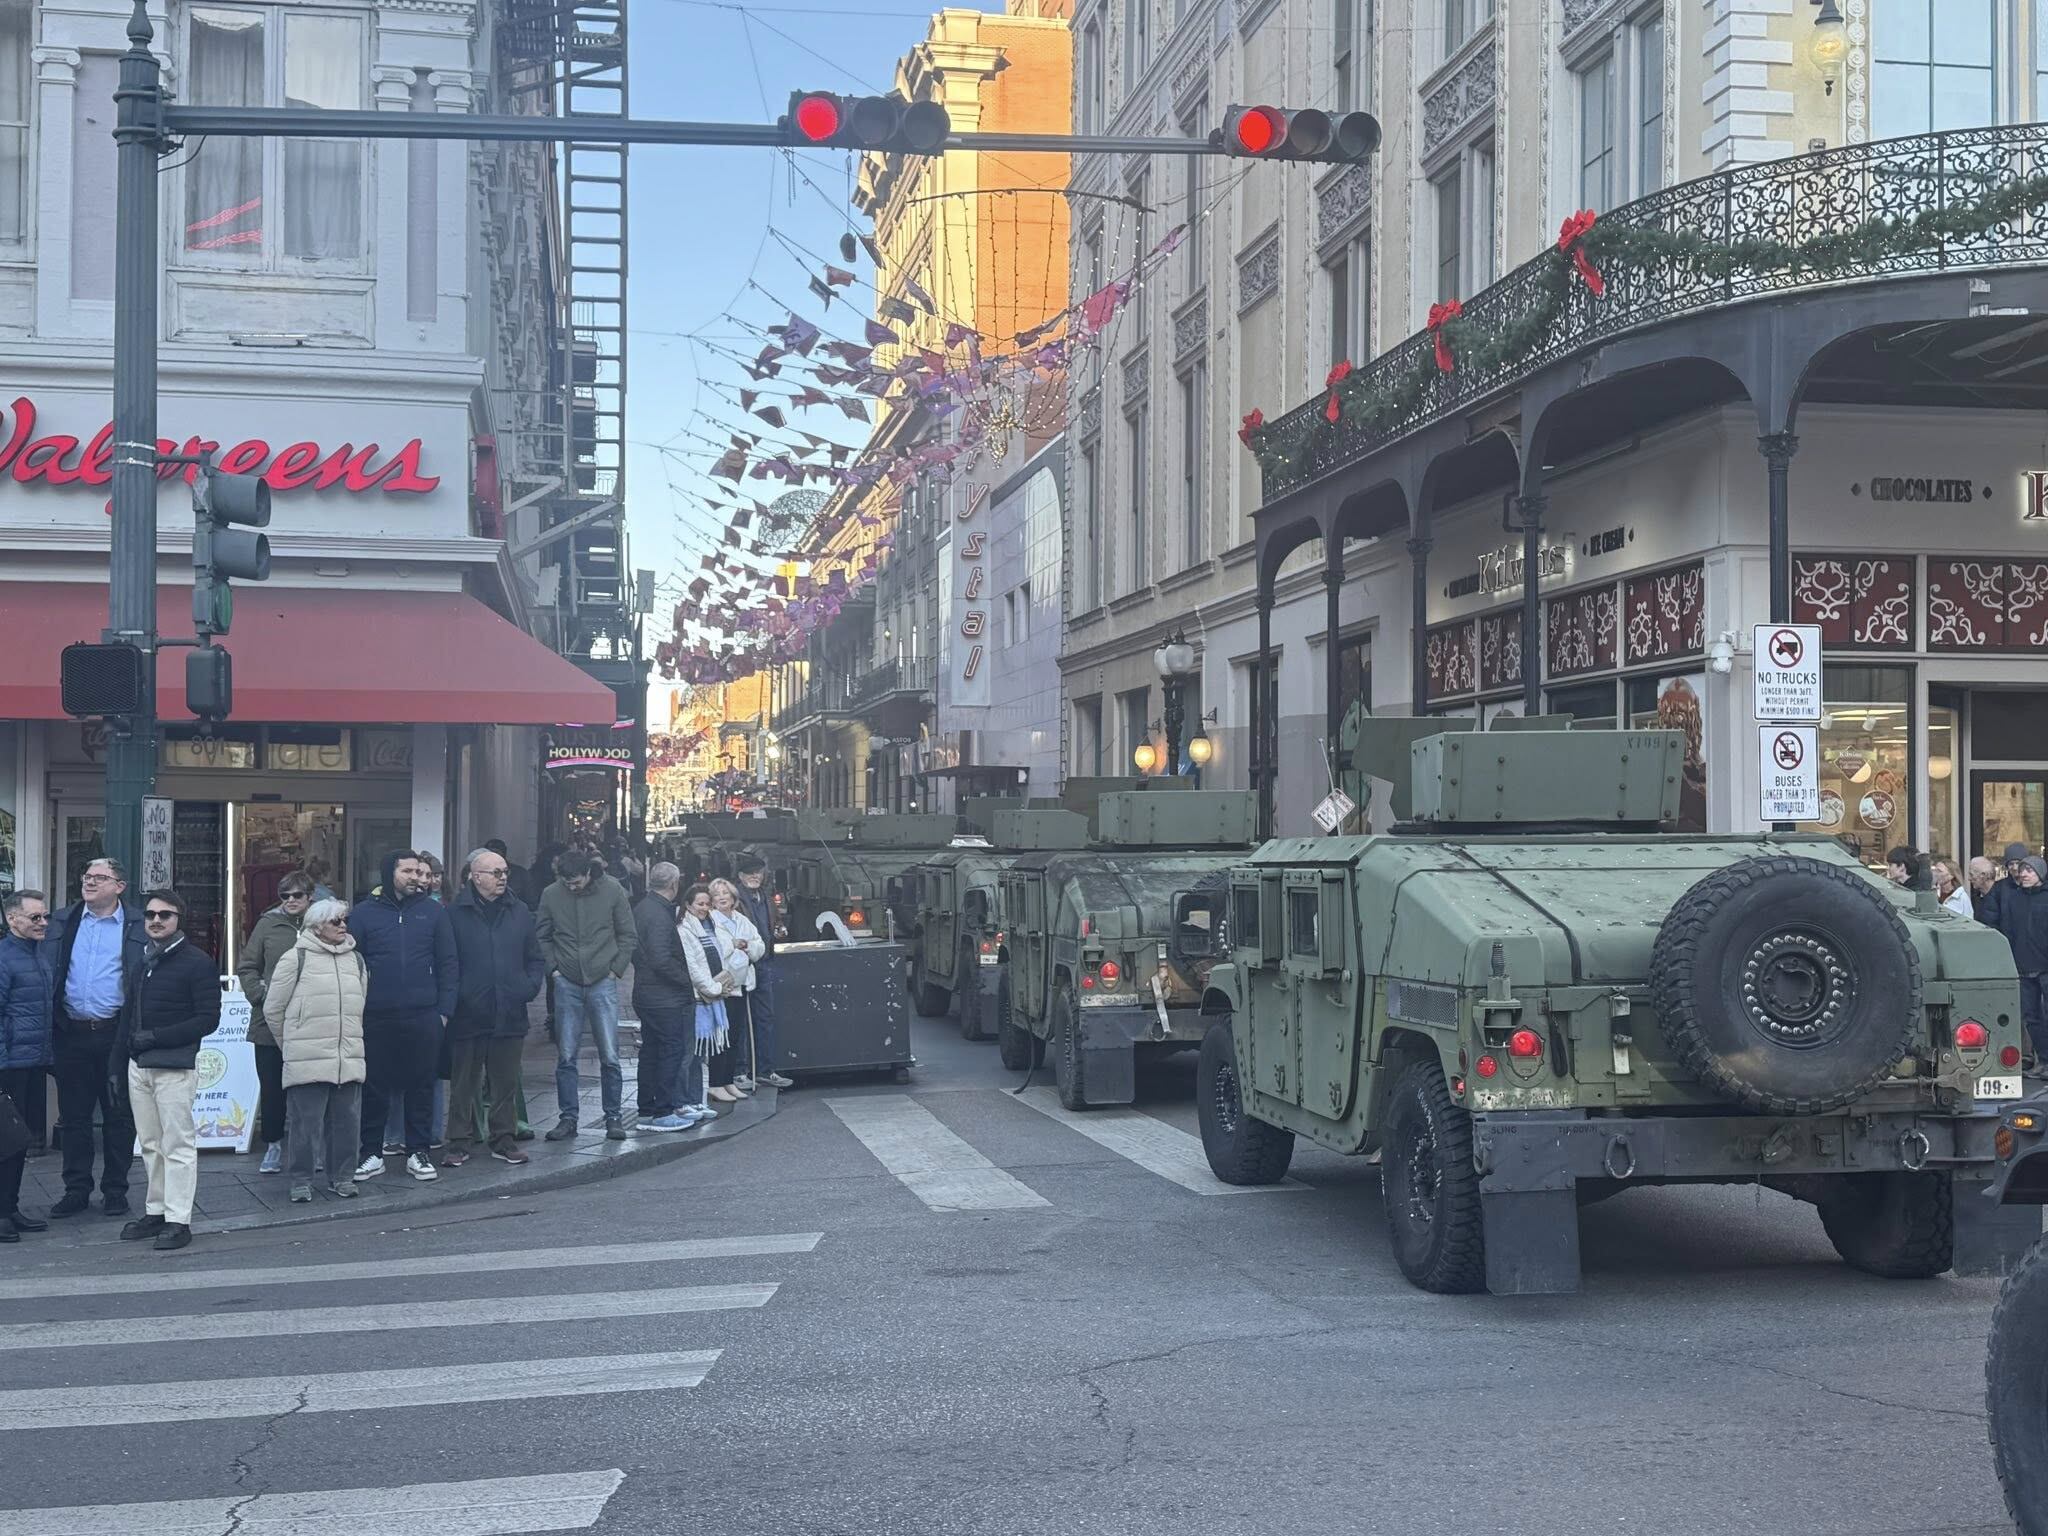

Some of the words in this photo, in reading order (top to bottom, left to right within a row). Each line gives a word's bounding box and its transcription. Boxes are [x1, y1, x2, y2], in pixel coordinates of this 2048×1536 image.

[0, 397, 440, 516] alreens
[1871, 477, 1973, 503] CHOCOLATES
[1477, 544, 1567, 595] Kilwns
[1758, 671, 1772, 684] NO
[1776, 672, 1817, 685] TRUCKS
[1761, 687, 1781, 696] LONGER
[1783, 687, 1798, 696] THAN
[1765, 697, 1788, 705] WITHOUT
[1790, 697, 1809, 705] PERMIT
[1802, 707, 1815, 715] FINE
[549, 747, 631, 759] HOLLYWOOD
[1775, 776, 1802, 787] BUSES
[1762, 789, 1783, 800] LONGER
[1785, 789, 1799, 799] THAN
[1773, 801, 1805, 813] PROHIBITED
[150, 806, 166, 825] NO
[149, 831, 167, 844] TURN
[152, 850, 163, 862] ON
[229, 1007, 252, 1016] CHE
[204, 1092, 228, 1100] HERE
[1491, 1126, 1517, 1135] SLING
